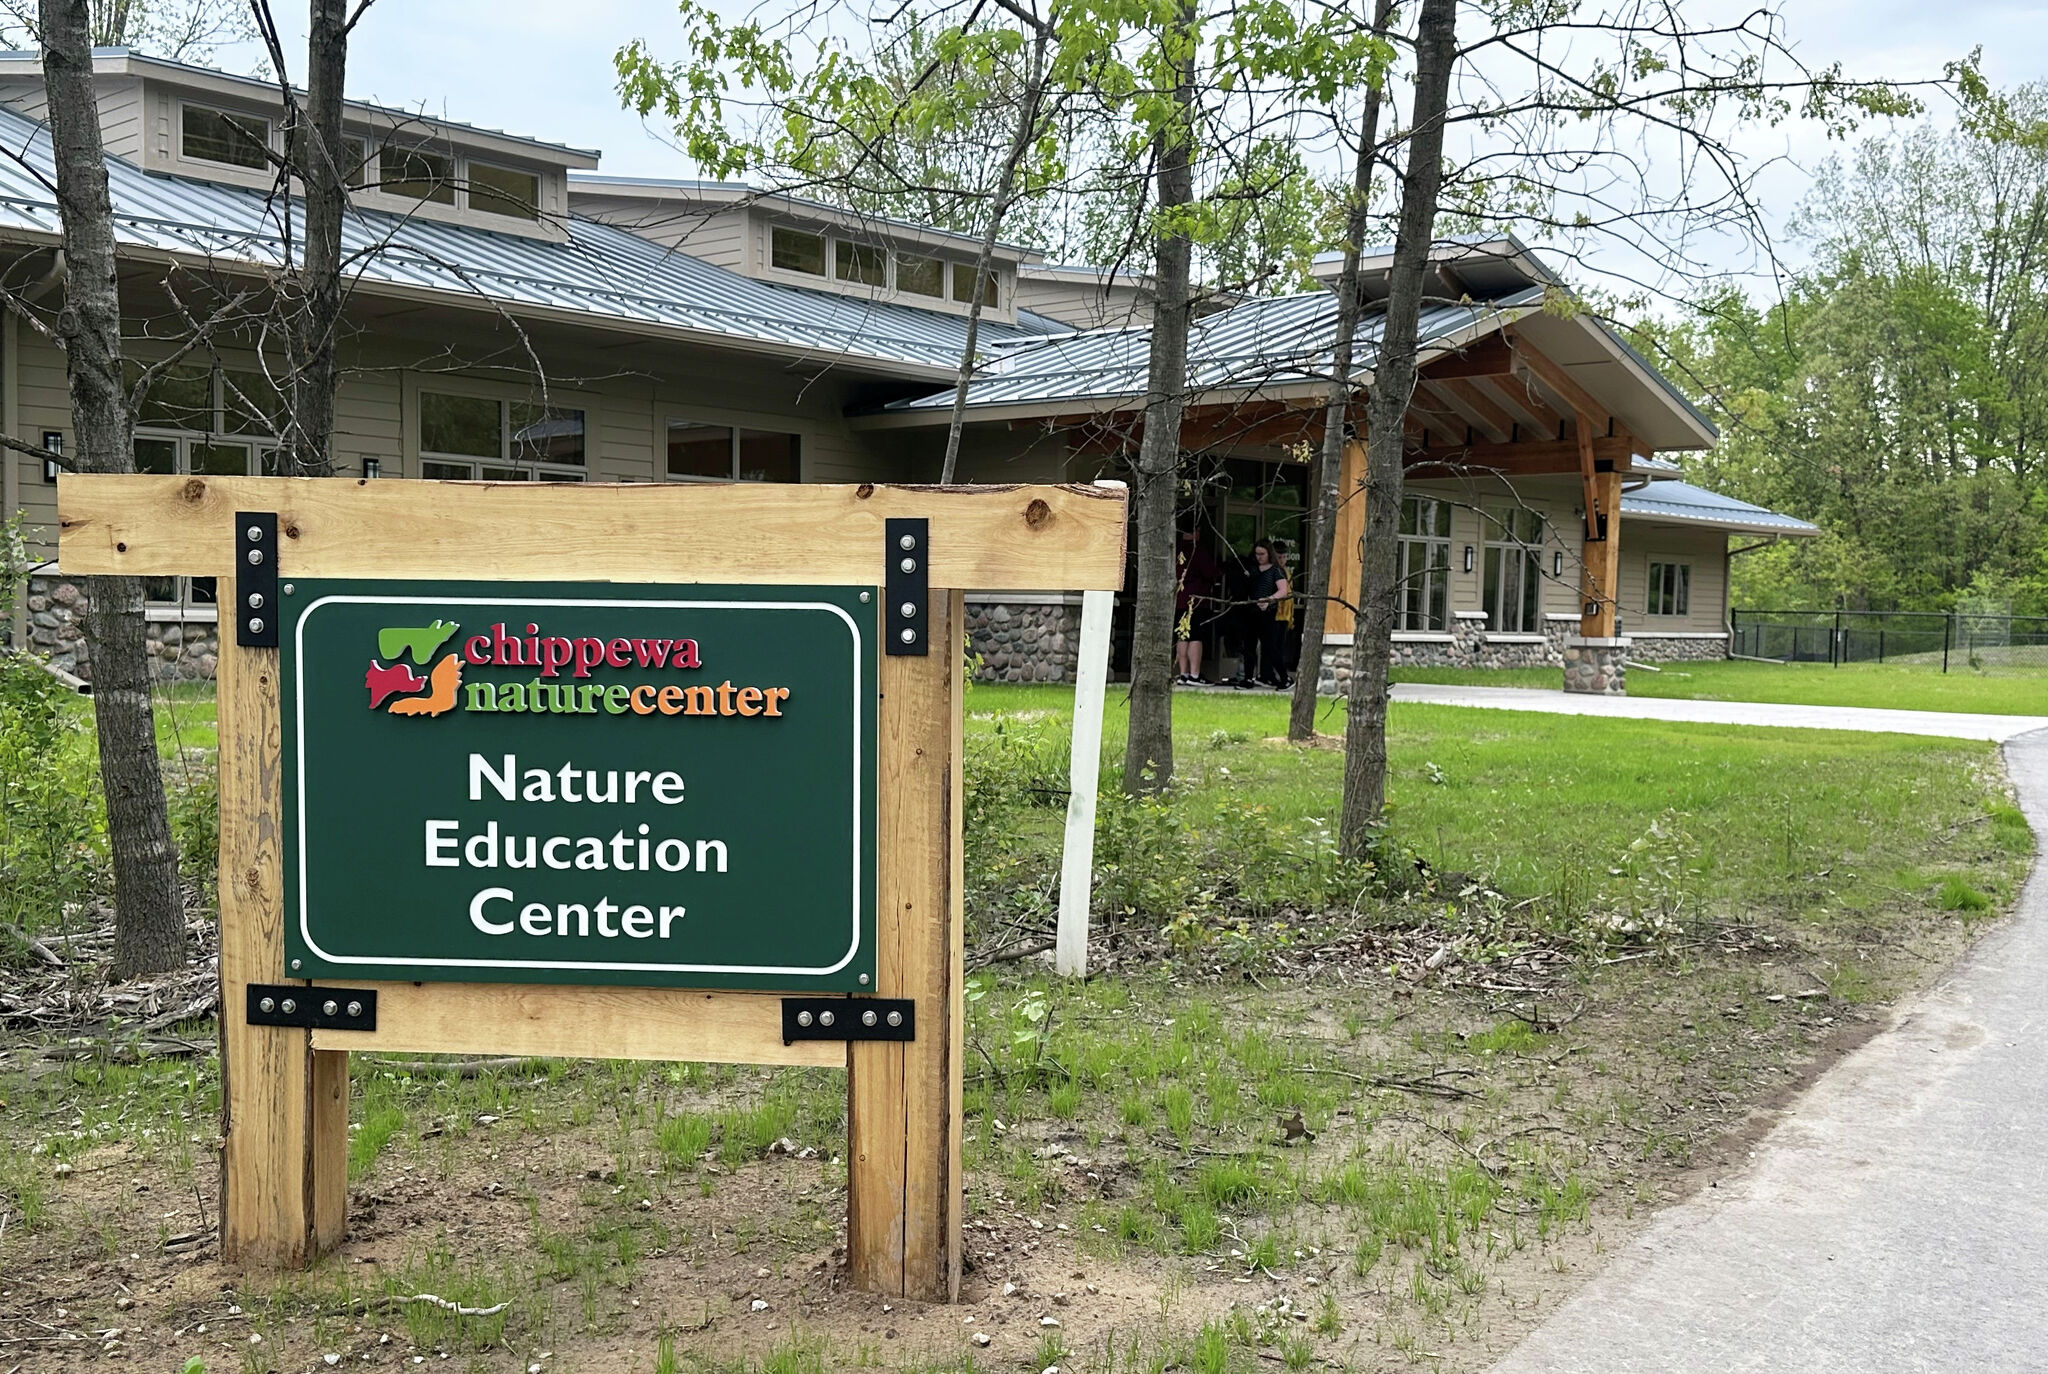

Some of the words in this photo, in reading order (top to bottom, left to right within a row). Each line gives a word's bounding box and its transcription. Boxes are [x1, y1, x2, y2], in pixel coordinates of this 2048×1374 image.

[1268, 535, 1296, 548] Nre
[465, 623, 702, 678] chippewa
[465, 677, 790, 717] naturecenter
[469, 753, 685, 804] Nature
[425, 819, 728, 873] Education
[469, 887, 686, 939] Center
